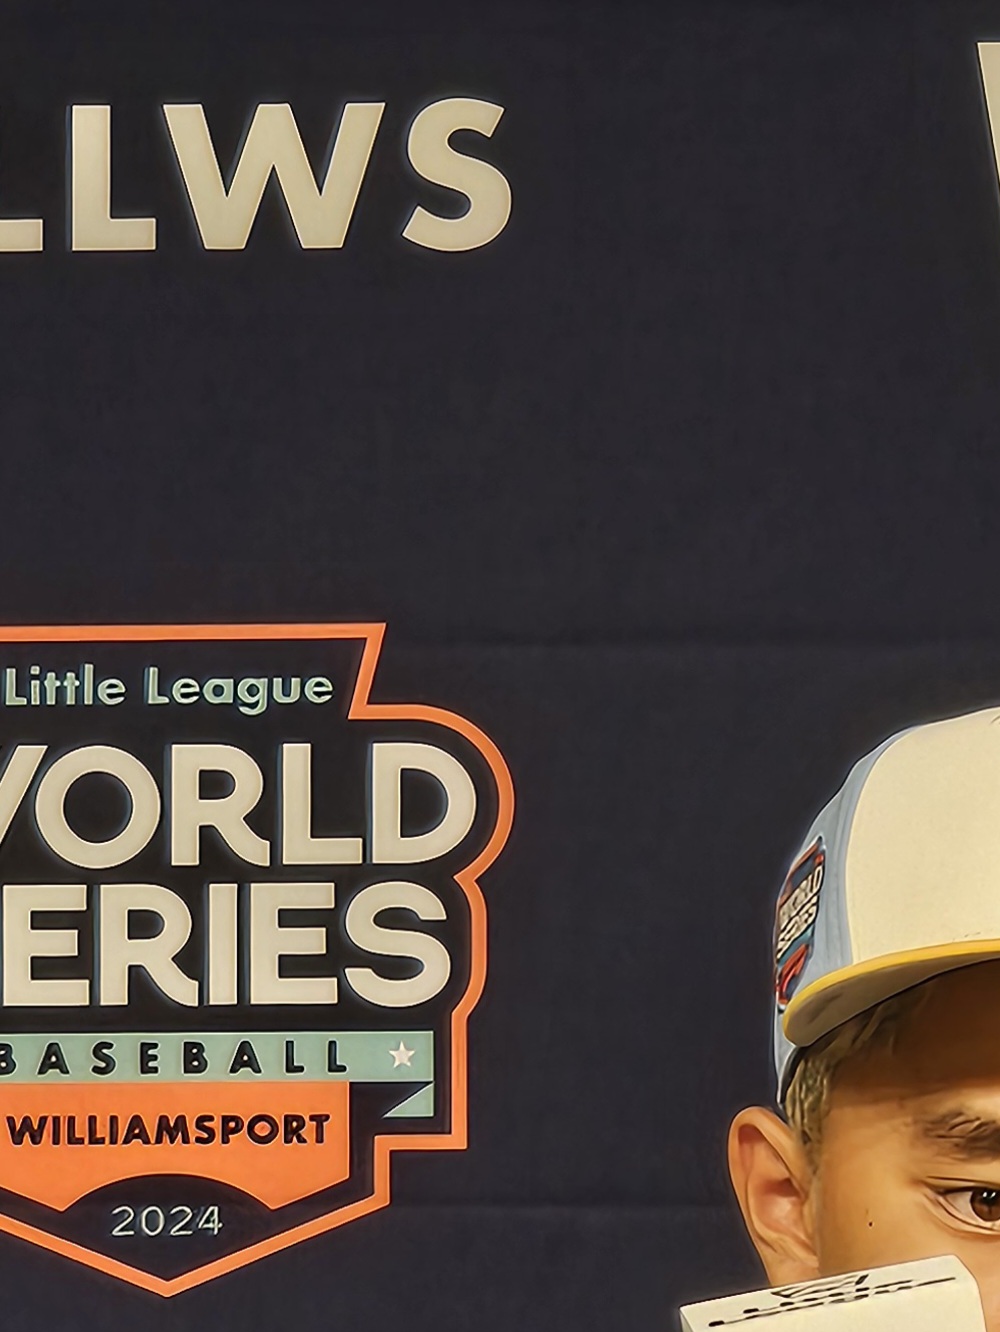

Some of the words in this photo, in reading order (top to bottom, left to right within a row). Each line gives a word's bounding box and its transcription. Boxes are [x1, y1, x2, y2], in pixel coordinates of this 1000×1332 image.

[5, 663, 127, 706] Little
[145, 666, 334, 716] League
[6, 1113, 331, 1145] WILLIAMSPORT
[110, 1205, 223, 1237] 2024
